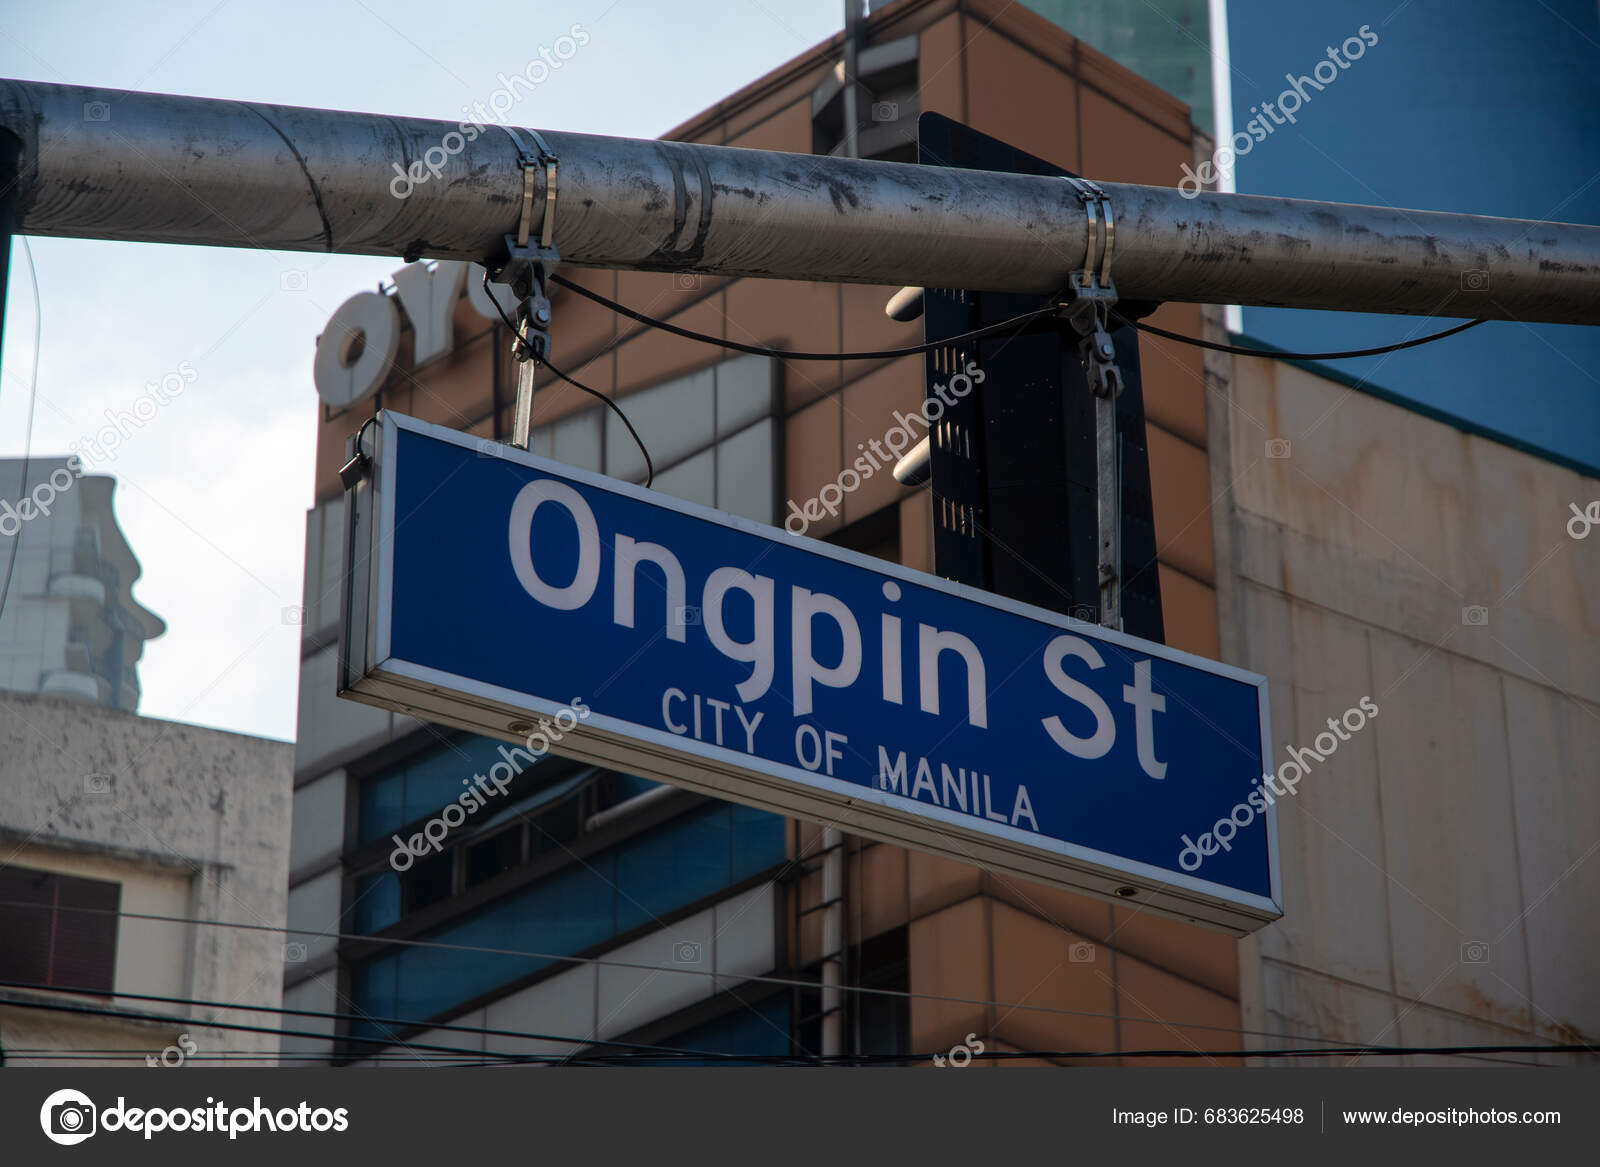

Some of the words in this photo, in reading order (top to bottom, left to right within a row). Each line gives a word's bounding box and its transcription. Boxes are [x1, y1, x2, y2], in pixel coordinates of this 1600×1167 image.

[508, 479, 988, 729] Ongpin
[1041, 634, 1168, 780] St
[662, 687, 764, 754] CITY
[795, 723, 848, 776] OF
[878, 744, 1040, 832] MANILA
